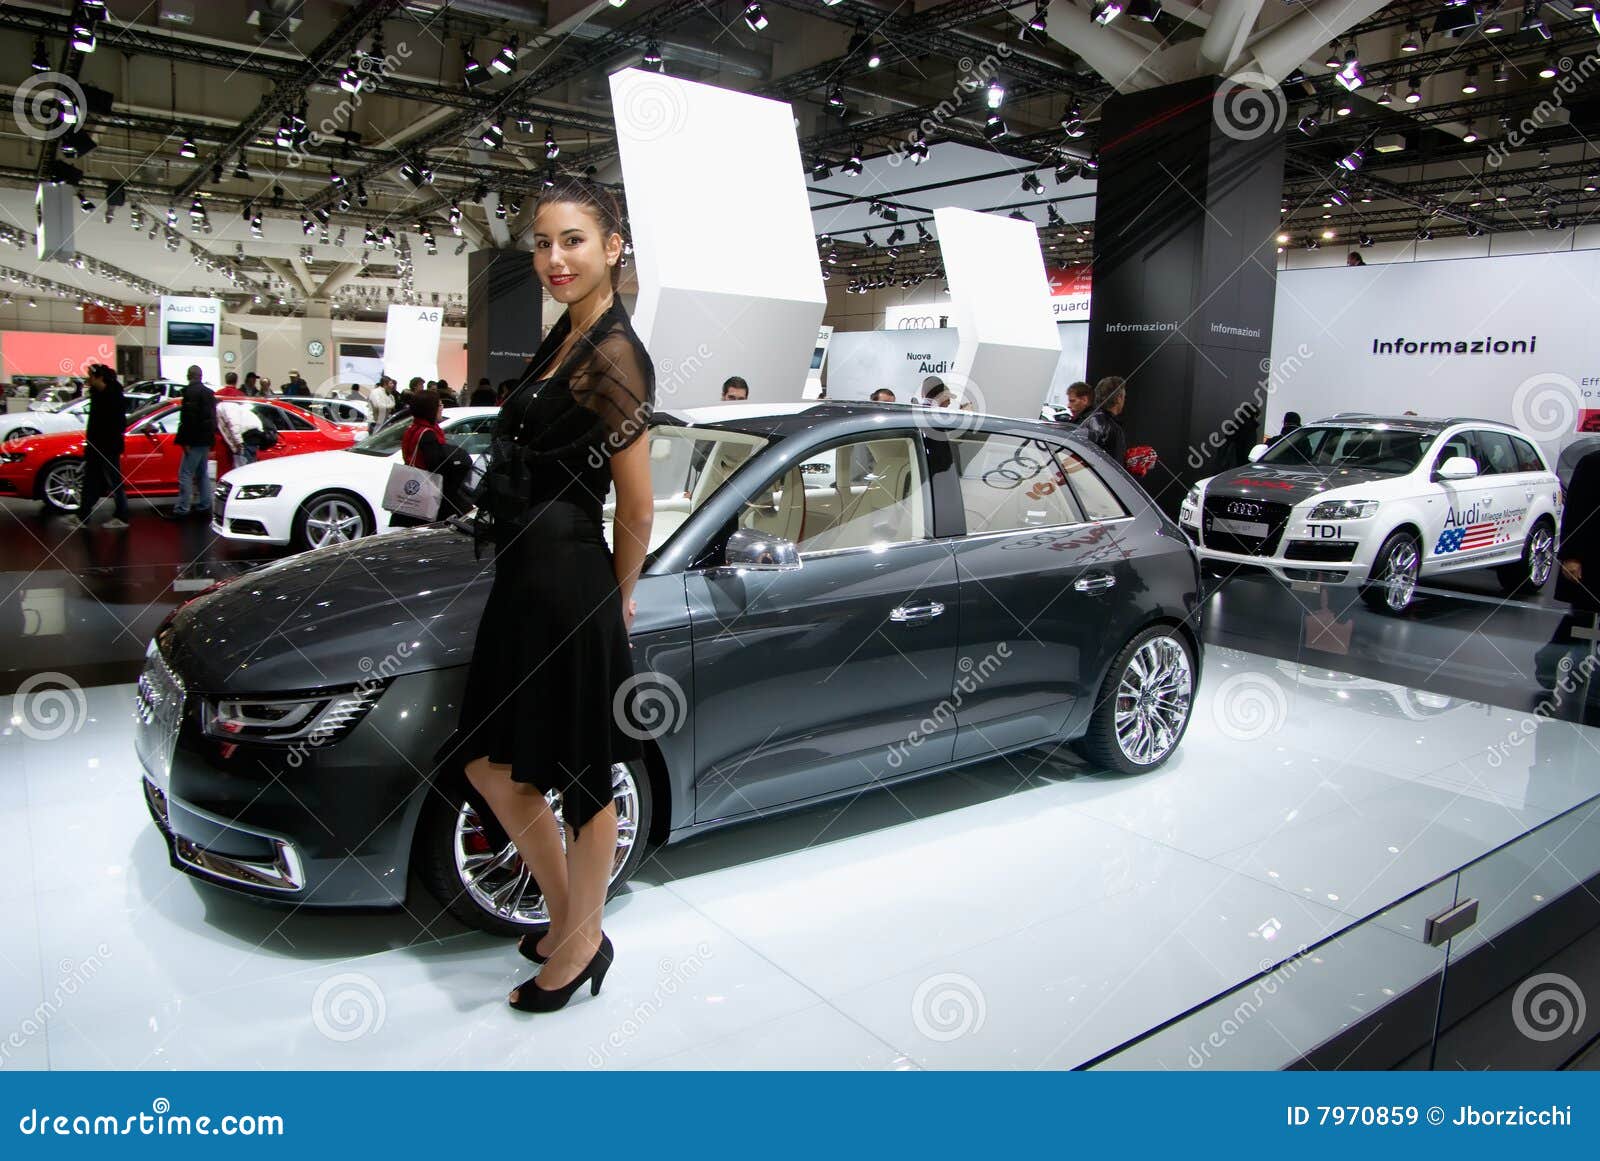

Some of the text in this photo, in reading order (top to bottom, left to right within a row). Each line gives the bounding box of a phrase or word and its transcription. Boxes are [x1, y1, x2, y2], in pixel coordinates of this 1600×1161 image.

[417, 311, 439, 322] A6
[1106, 321, 1178, 332] Informazioni
[1211, 323, 1260, 338] Informazioni
[1372, 336, 1537, 354] Informazioni
[907, 352, 931, 361] Nuova
[918, 361, 947, 374] Audi
[1444, 502, 1480, 529] Audi
[1307, 524, 1342, 539] TDI
